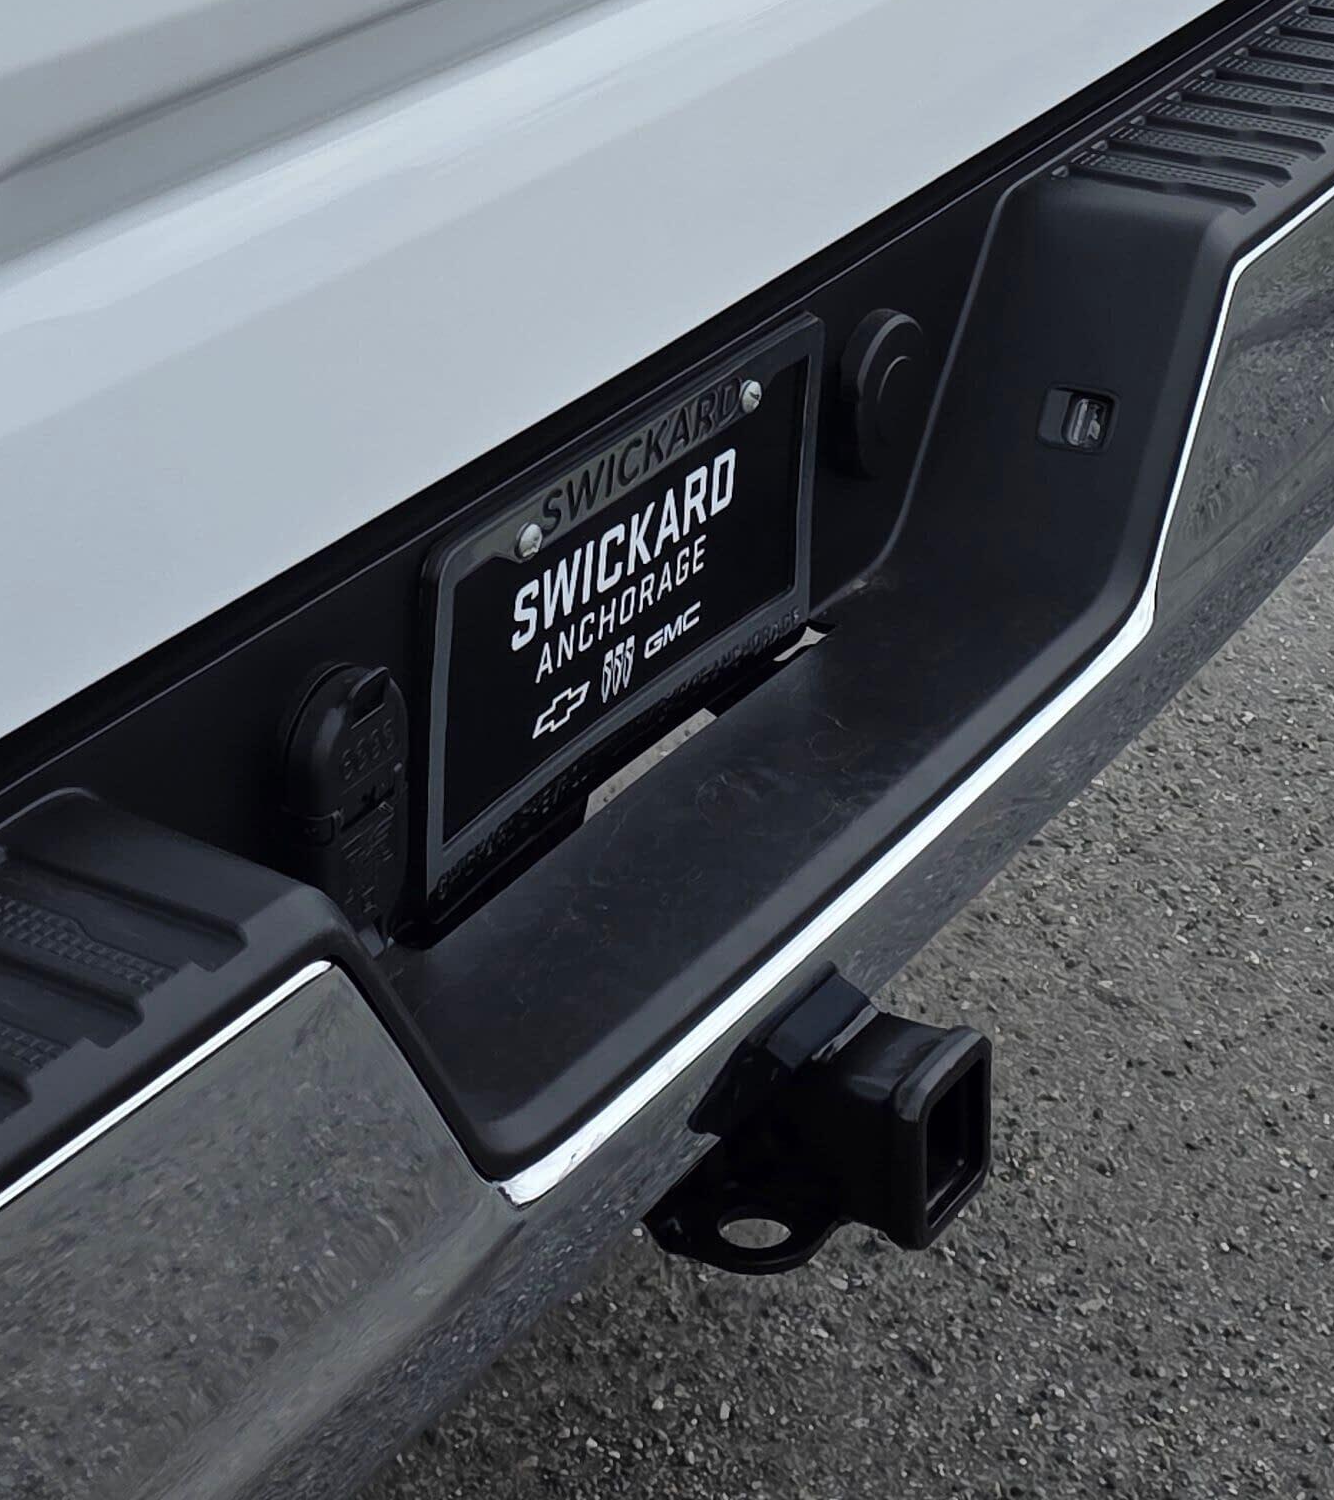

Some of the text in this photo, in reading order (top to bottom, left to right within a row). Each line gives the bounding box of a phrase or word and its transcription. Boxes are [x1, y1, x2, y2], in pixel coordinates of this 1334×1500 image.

[541, 378, 744, 537] SWICKARD
[511, 448, 737, 652] SWICKARD
[535, 534, 707, 684] ANCHORAGE
[644, 601, 701, 659] GMC
